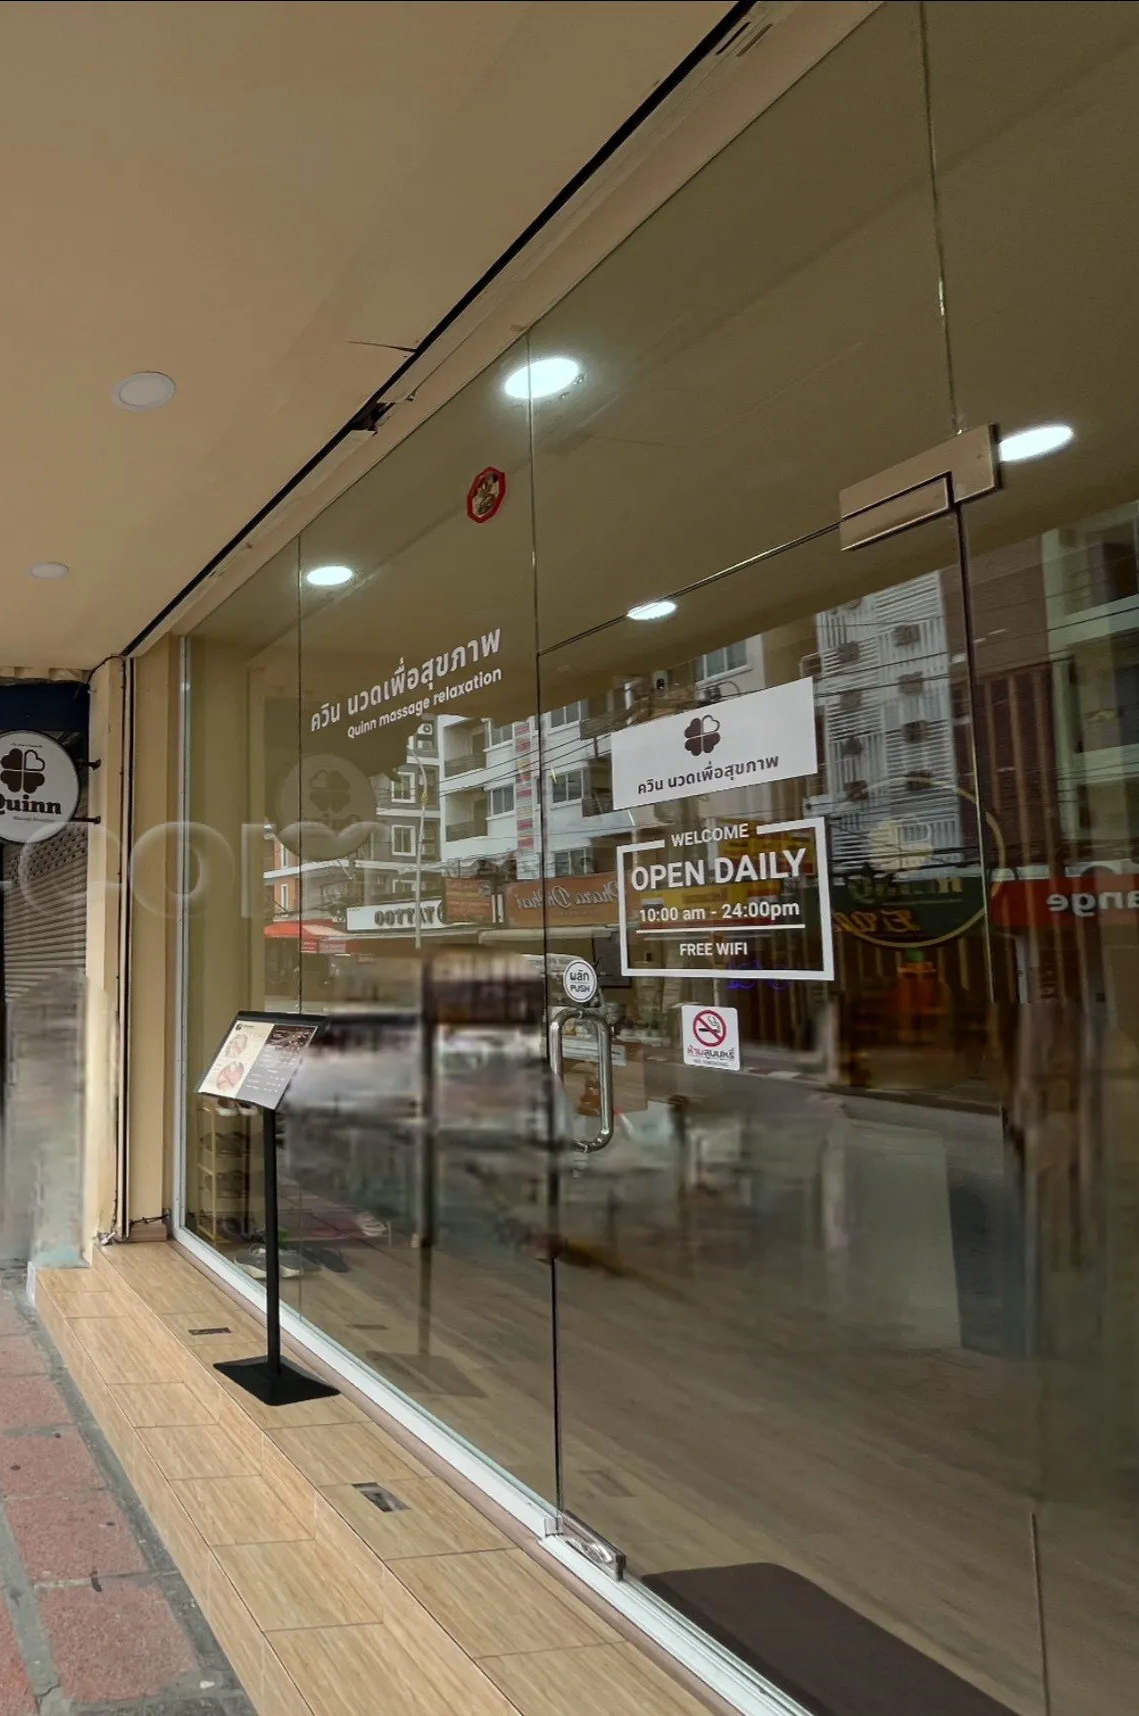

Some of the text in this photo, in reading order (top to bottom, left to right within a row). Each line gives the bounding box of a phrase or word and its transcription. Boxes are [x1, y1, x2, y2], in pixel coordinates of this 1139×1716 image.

[311, 628, 502, 732] ควิน นวดเพื่อสุขภาพ
[347, 668, 502, 740] Quinn massage relaxation
[637, 755, 780, 795] ควิน นวดเพื่อสุขภาพ
[671, 823, 749, 847] WELCOME
[631, 848, 806, 891] OPEN DAILY
[639, 906, 678, 922] 10:00
[682, 907, 706, 920] am
[721, 901, 800, 920] 24:00pm
[679, 942, 748, 956] FREE WIFI
